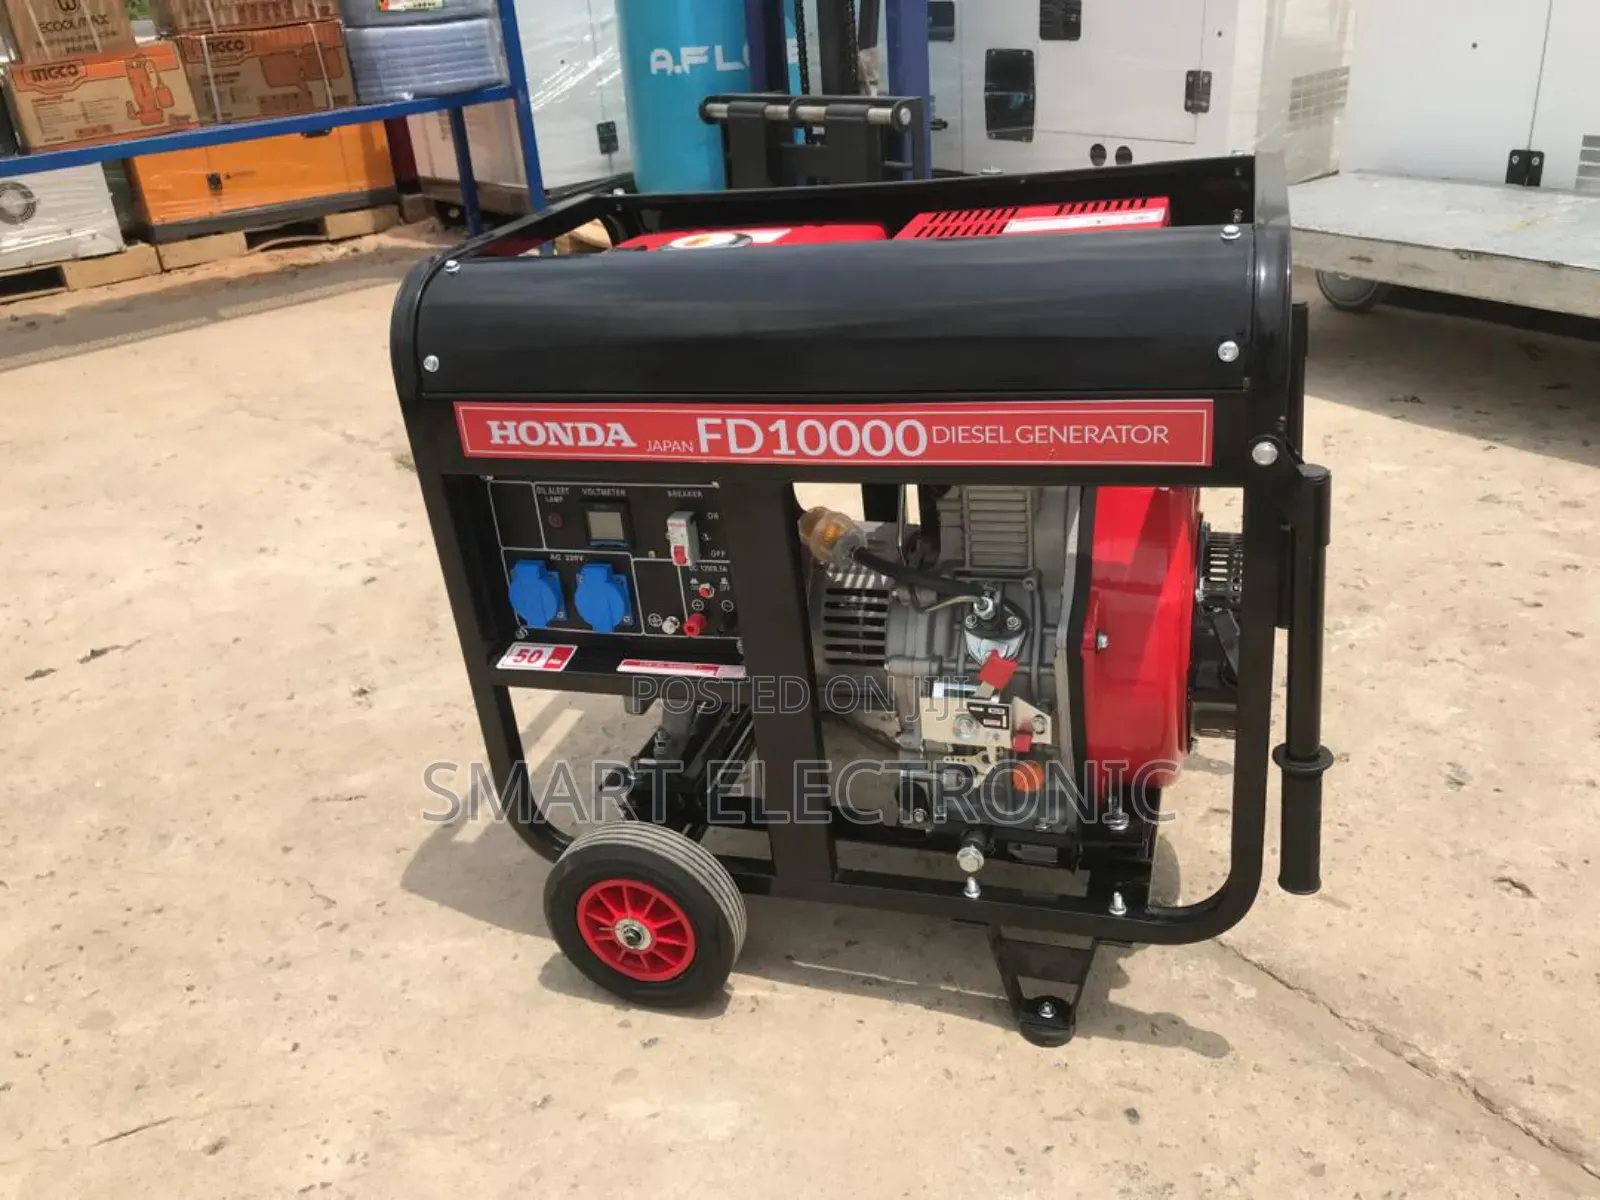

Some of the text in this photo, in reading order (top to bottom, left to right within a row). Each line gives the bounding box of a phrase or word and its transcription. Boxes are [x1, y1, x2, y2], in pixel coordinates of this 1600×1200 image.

[486, 416, 1169, 457] HONDA JAPAN FD10000 DIESEL GENERATOR
[513, 648, 544, 664] 50
